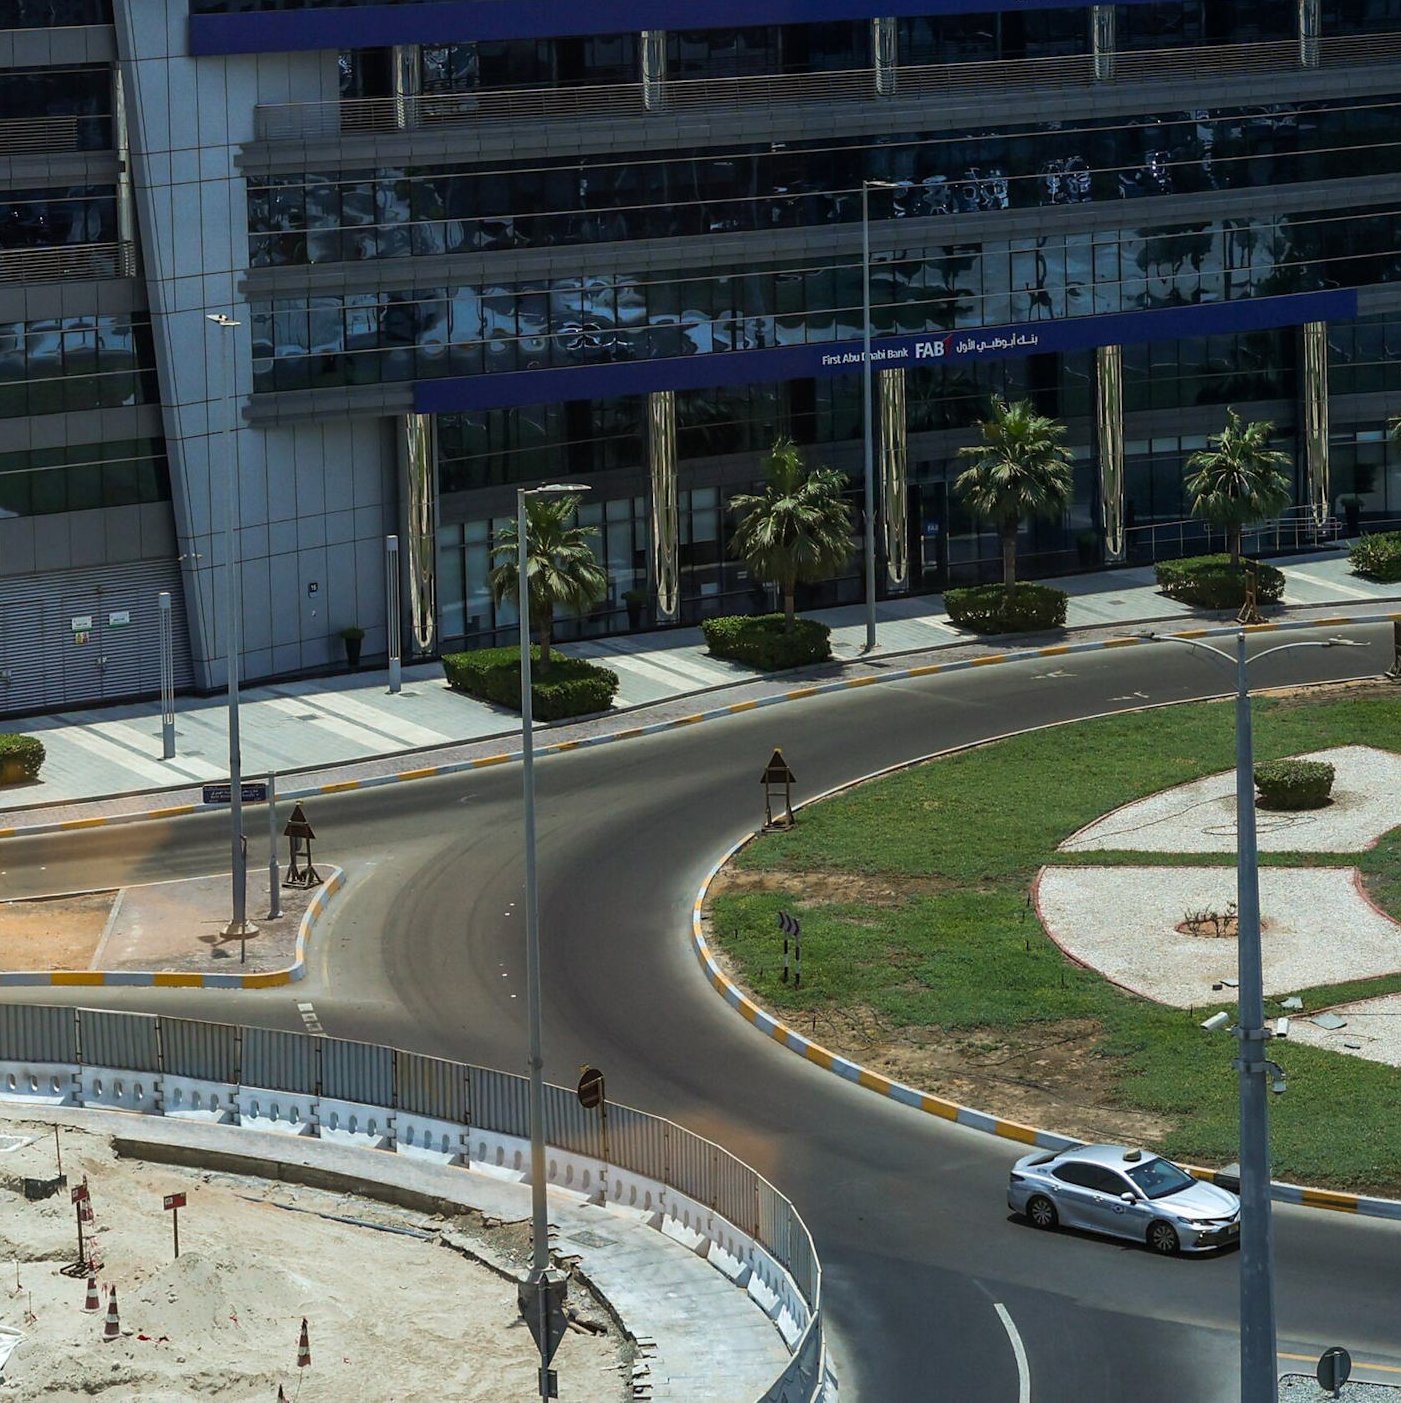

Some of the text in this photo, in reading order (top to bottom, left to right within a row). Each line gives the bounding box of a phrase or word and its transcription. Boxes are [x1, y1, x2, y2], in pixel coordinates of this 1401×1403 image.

[977, 333, 1016, 353] أبوظبي
[1017, 334, 1038, 345] بنك
[822, 354, 841, 365] First
[842, 352, 860, 364] Abu
[887, 347, 909, 359] Bank
[915, 341, 944, 358] FAB
